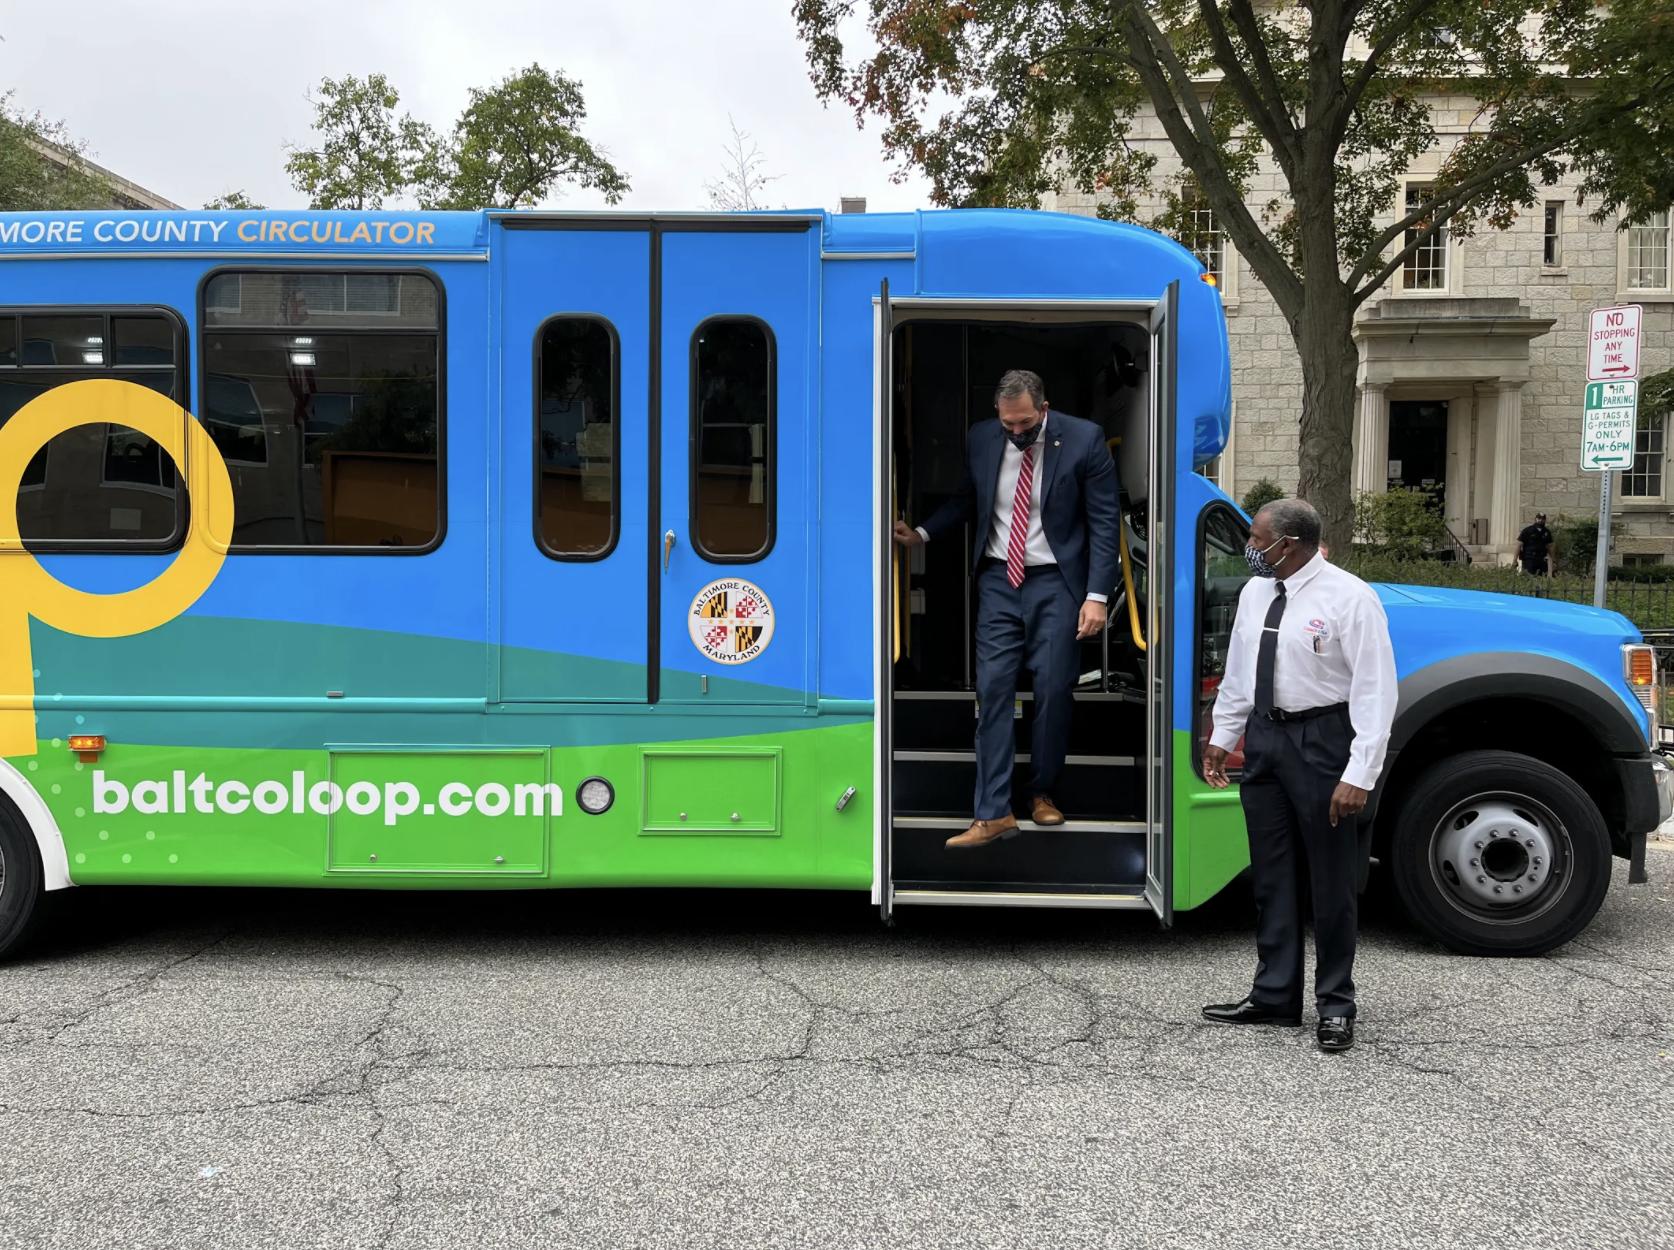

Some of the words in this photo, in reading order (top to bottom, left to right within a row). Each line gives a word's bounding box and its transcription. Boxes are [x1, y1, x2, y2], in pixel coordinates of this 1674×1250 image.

[93, 220, 229, 242] COUNTY
[237, 221, 435, 244] CIRCULATOR
[1606, 312, 1624, 327] NO
[1593, 327, 1636, 341] STOPPING
[1604, 340, 1623, 352] ANY
[1603, 353, 1623, 364] TIME
[1592, 386, 1598, 406] 1
[1612, 384, 1625, 395] HR
[1602, 394, 1633, 406] PARKING
[1590, 412, 1600, 421] LG
[1602, 411, 1621, 420] TAGS
[1623, 410, 1630, 419] &
[1588, 420, 1631, 430] G-PERMITS
[1595, 430, 1622, 440] ONLY
[1586, 440, 1630, 452] 7AM-6PM
[693, 582, 740, 616] BALTIMORE
[742, 585, 770, 616] COUNTY
[702, 644, 761, 661] MARYLAND
[92, 770, 564, 826] baltcoloop.com
